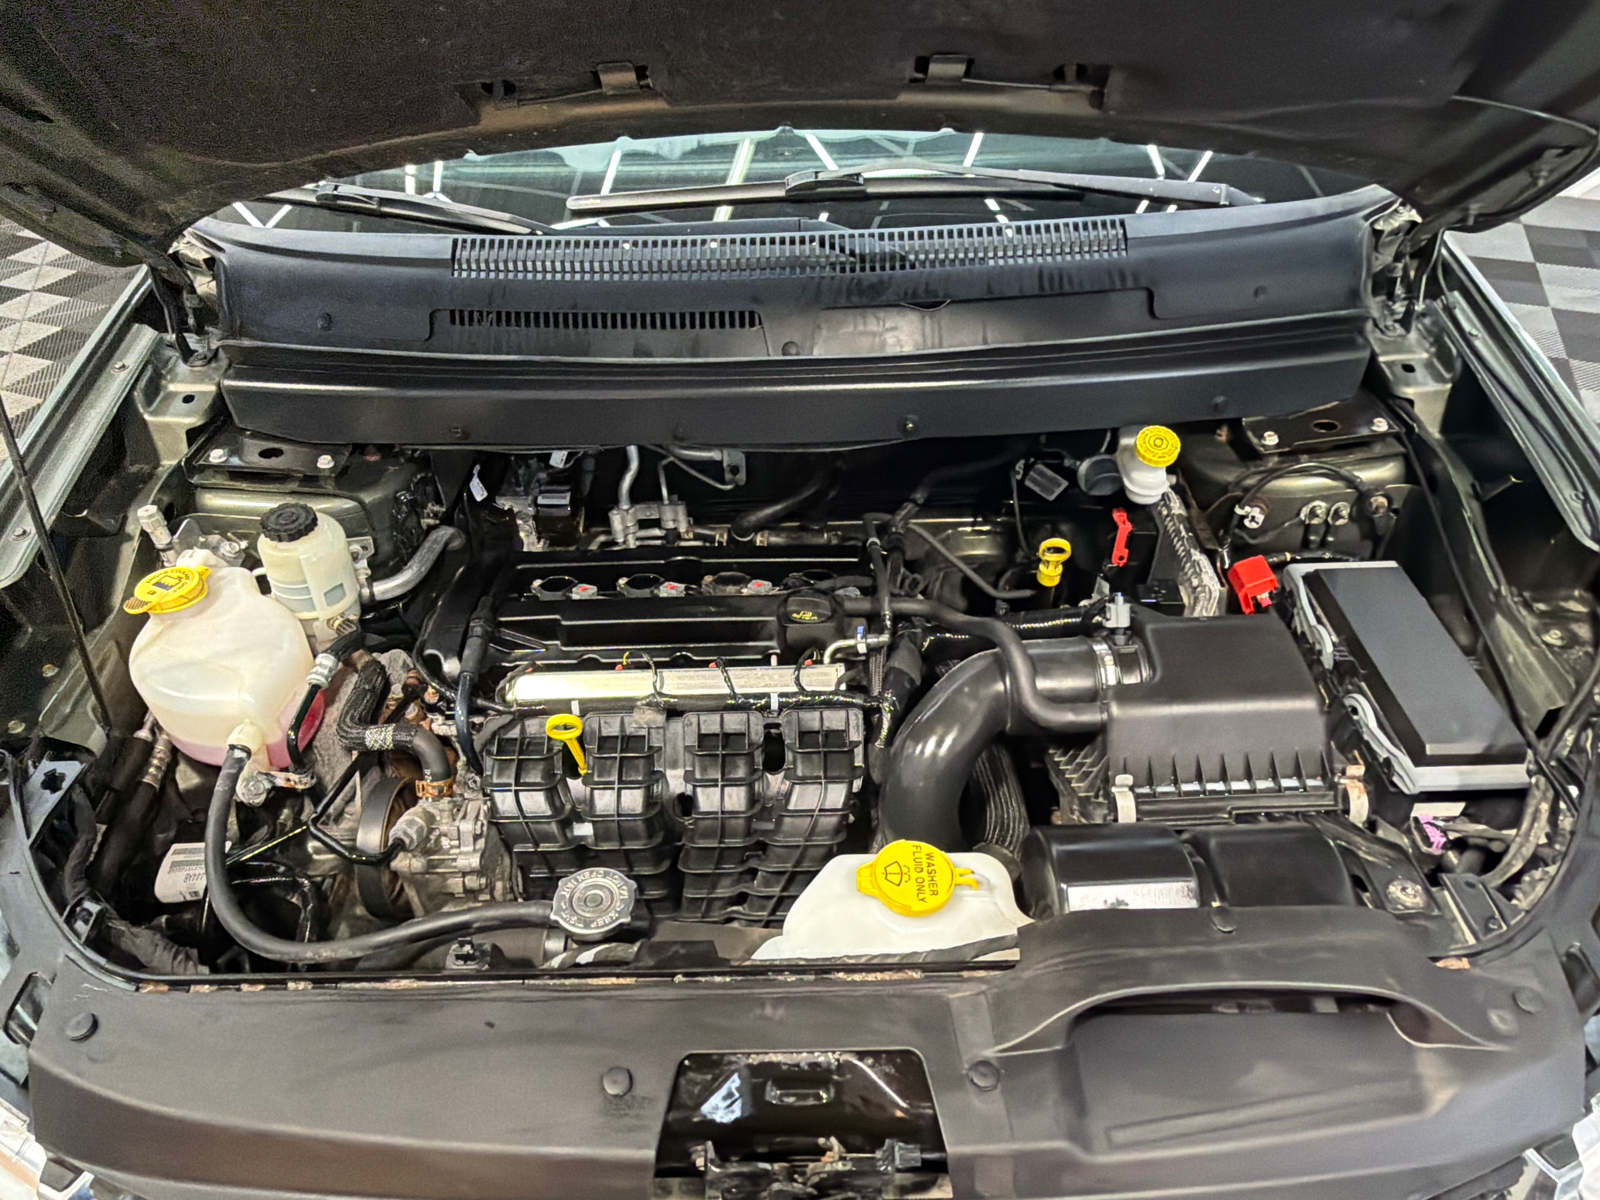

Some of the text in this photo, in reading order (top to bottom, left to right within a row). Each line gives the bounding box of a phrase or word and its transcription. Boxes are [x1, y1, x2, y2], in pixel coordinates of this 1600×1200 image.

[912, 845, 927, 904] FLUID ONLY
[925, 852, 939, 896] WASHER
